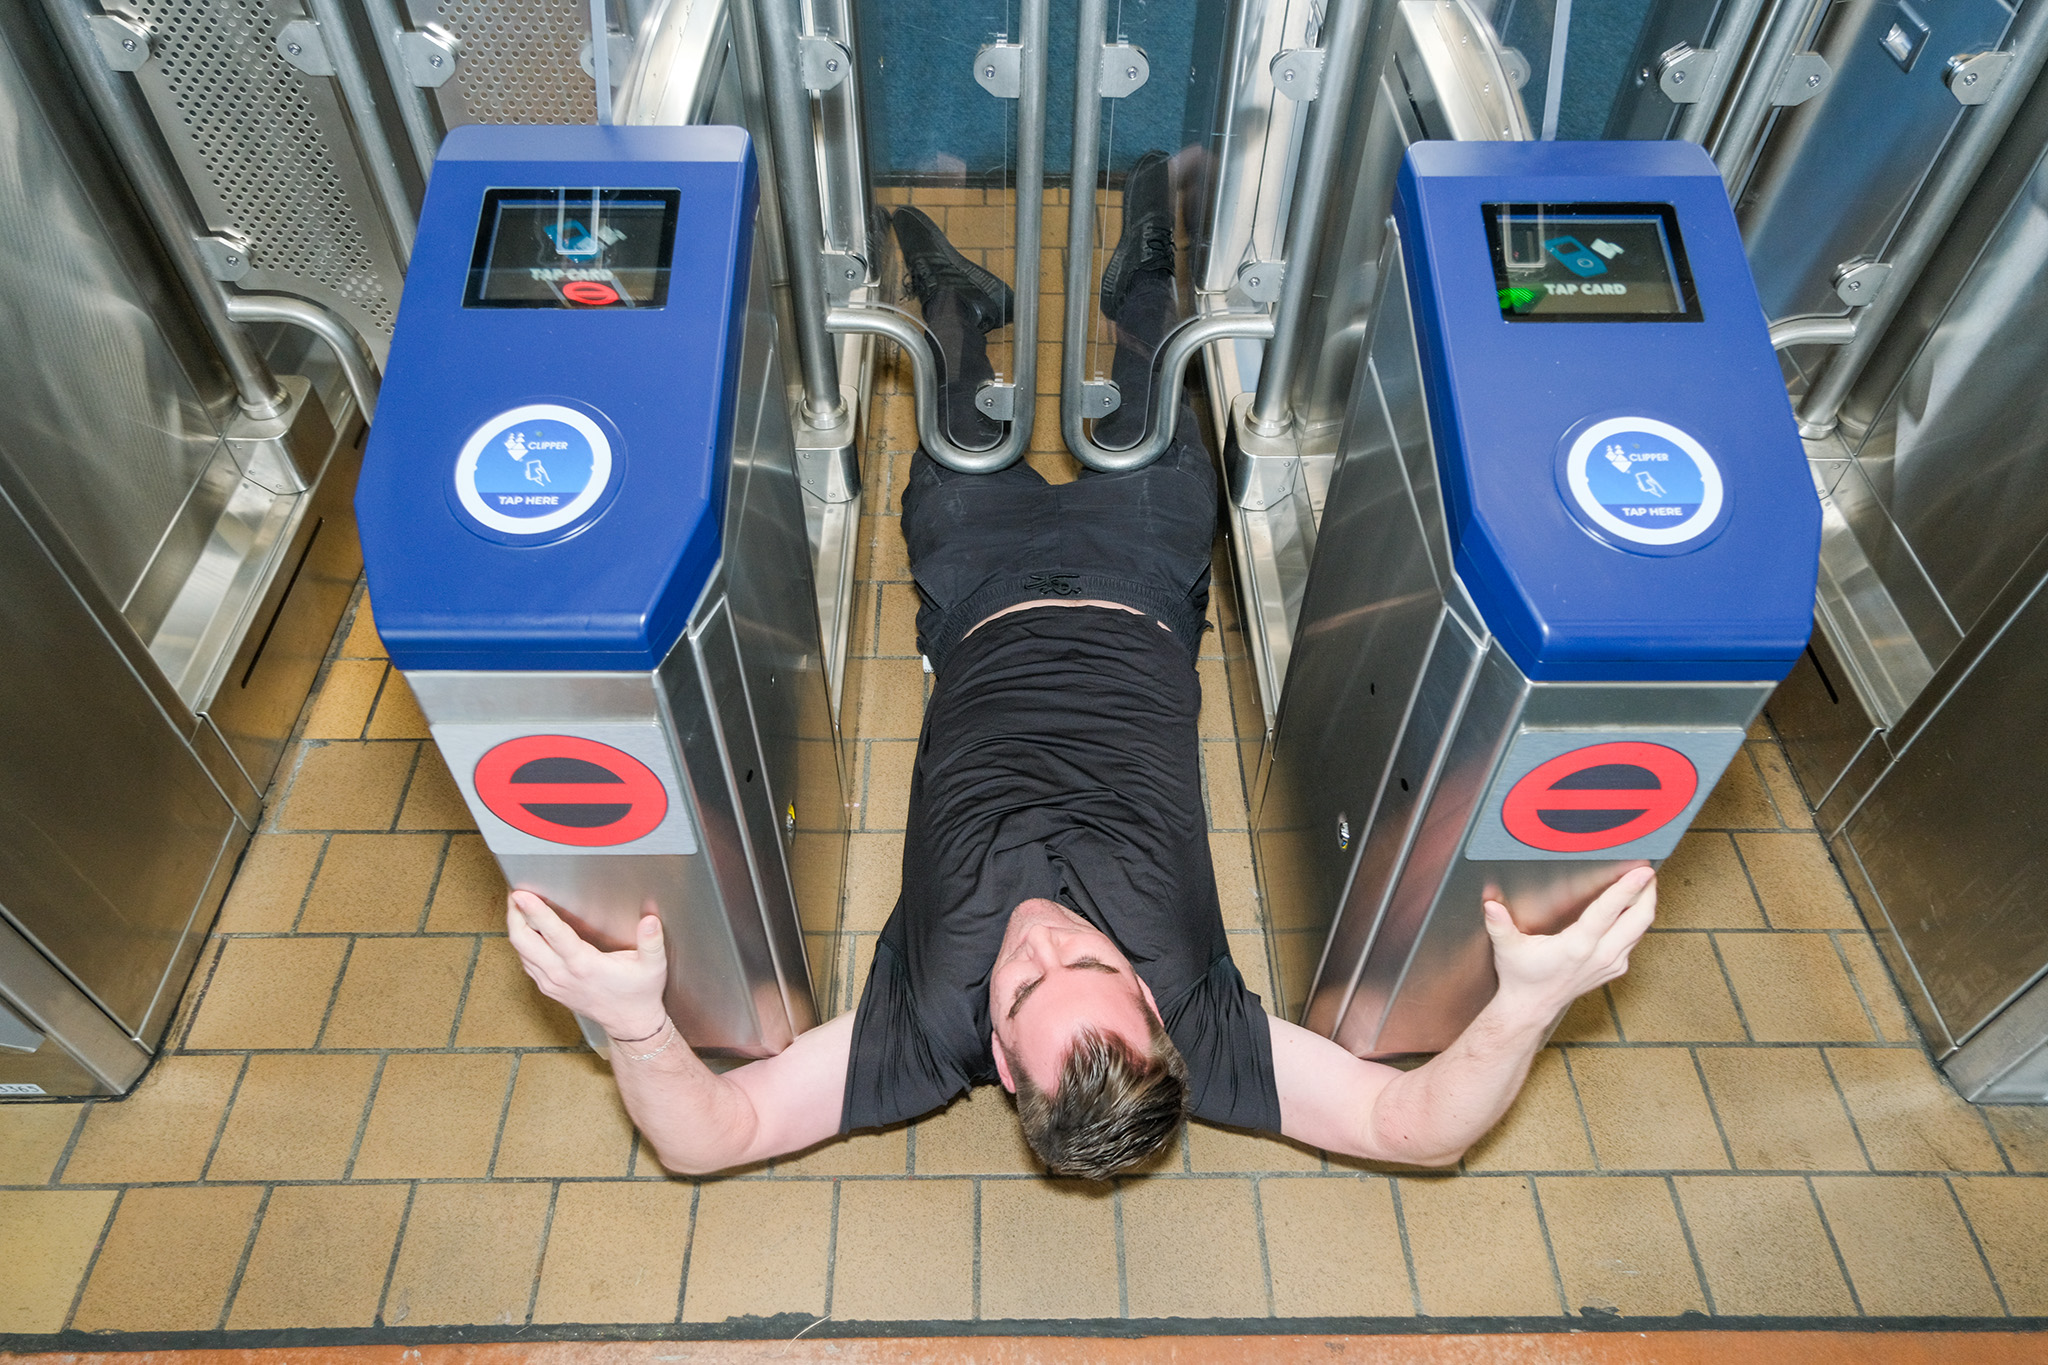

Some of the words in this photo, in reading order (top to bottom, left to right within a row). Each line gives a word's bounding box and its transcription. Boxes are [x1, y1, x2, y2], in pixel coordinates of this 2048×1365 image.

[1545, 283, 1578, 295] TAP
[1581, 283, 1627, 295] CARD
[527, 441, 569, 450] CLIPPER
[1628, 453, 1670, 462] CLIPPER
[499, 496, 524, 505] TAP
[525, 496, 560, 505] HERE
[1622, 507, 1647, 516] TAP
[1649, 507, 1683, 516] HERE
